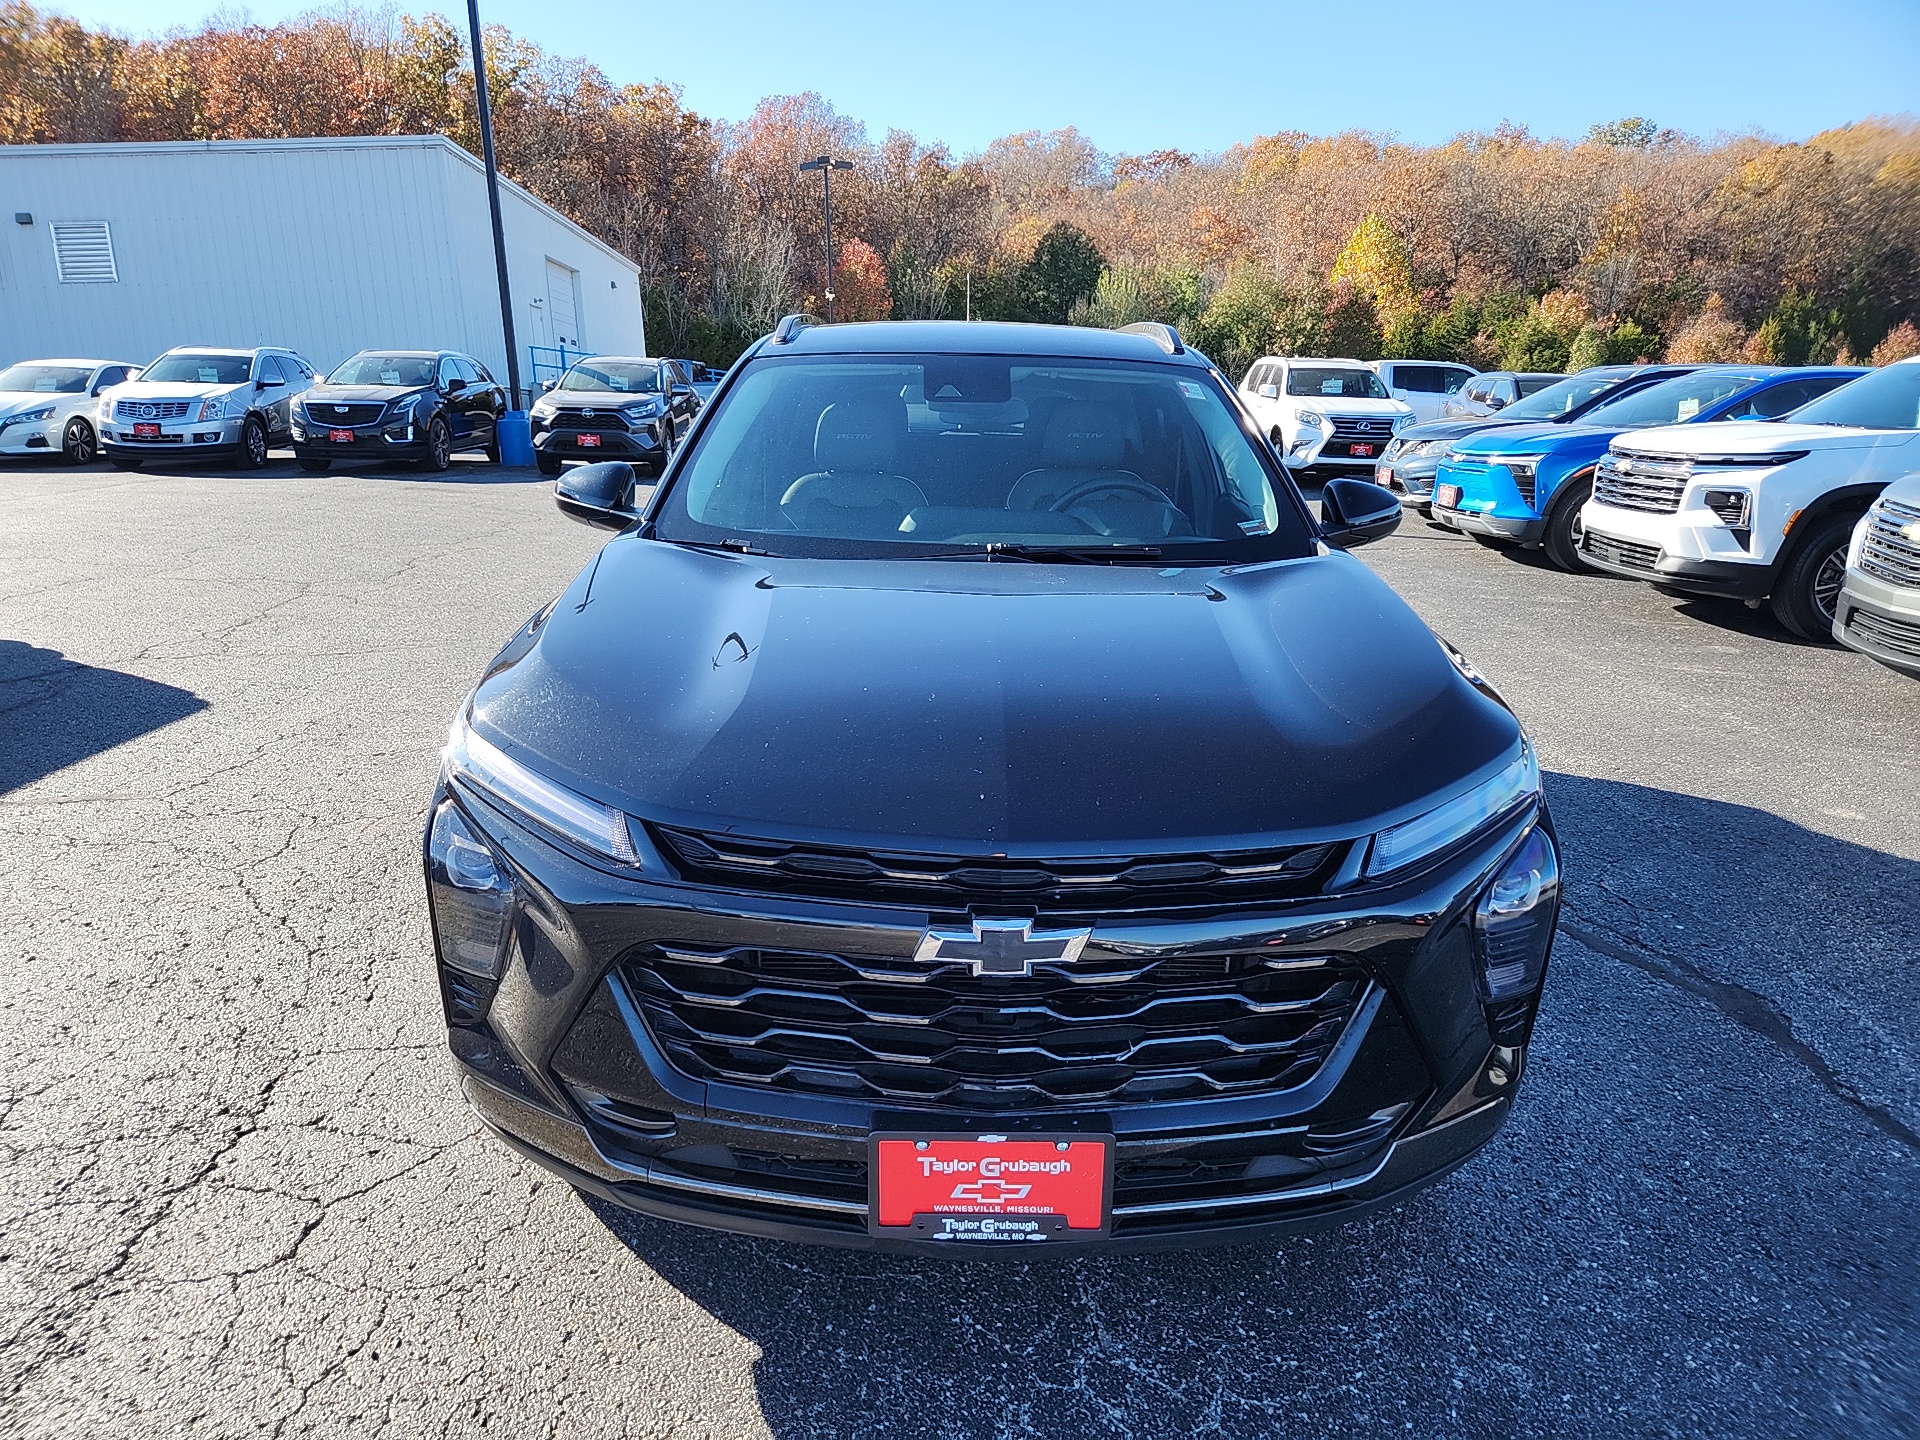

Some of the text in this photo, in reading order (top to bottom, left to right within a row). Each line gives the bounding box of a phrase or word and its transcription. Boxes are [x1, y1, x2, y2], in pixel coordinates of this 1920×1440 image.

[916, 1156, 1071, 1177] Taylor Grubaugh
[933, 1204, 1054, 1215] WAYNESVILLE, MISSOURI
[941, 1218, 1039, 1233] Taylor Grubaugh
[955, 1232, 1026, 1241] WAYNESVILLE, MO
